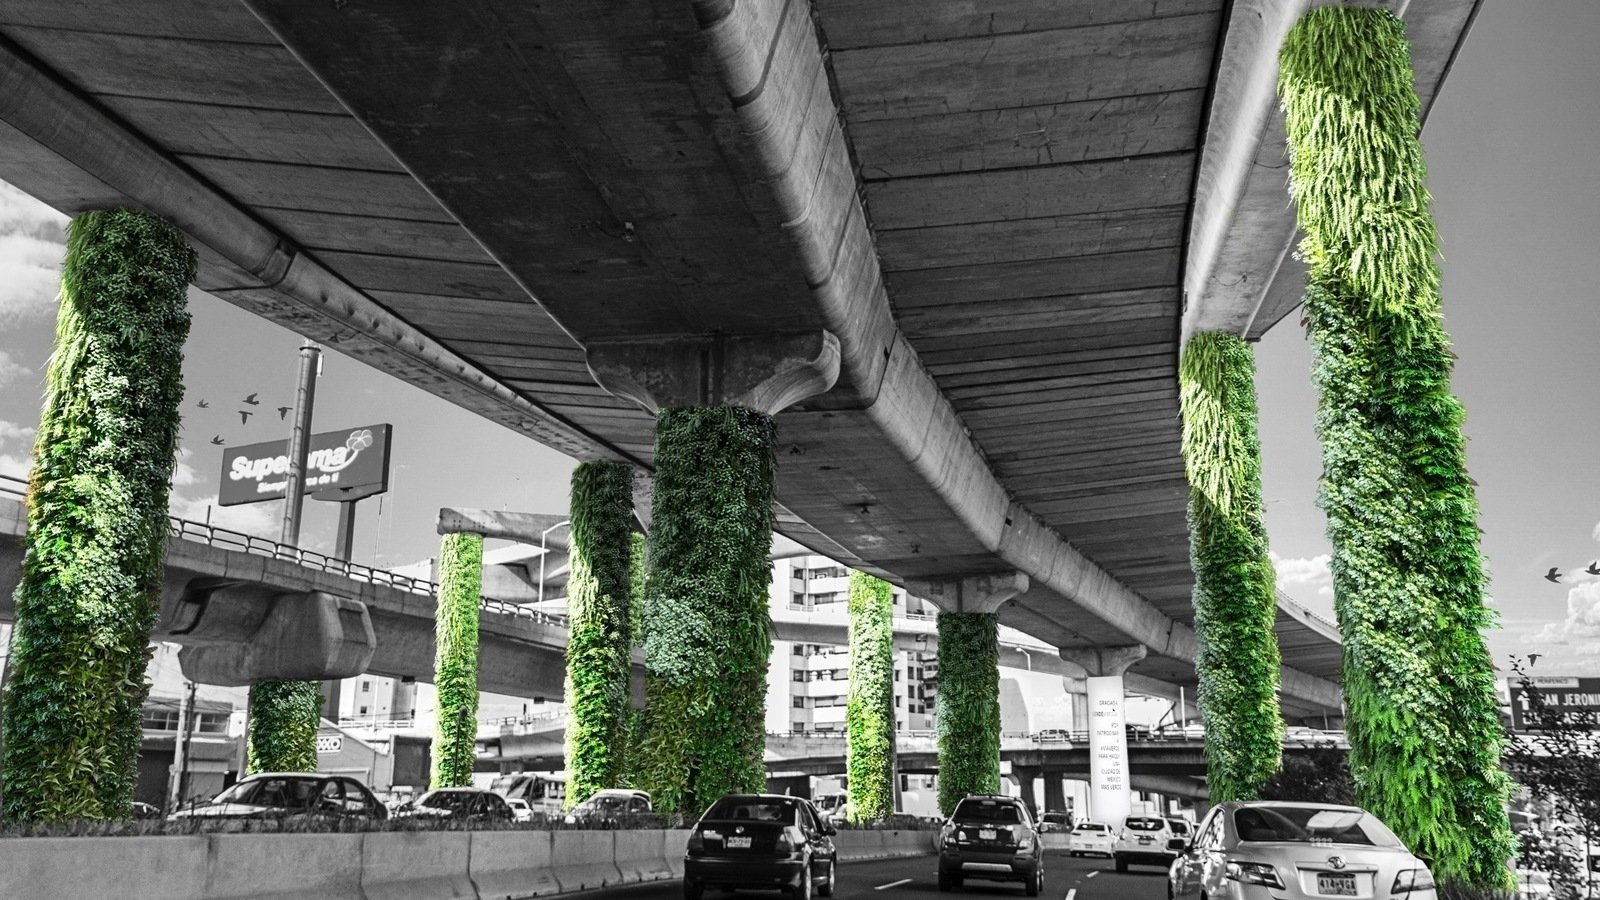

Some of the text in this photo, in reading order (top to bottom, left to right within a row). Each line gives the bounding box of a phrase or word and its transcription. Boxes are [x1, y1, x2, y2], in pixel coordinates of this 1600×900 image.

[229, 446, 347, 481] Supema
[1563, 693, 1600, 706] JERONI
[316, 738, 341, 751] XXO
